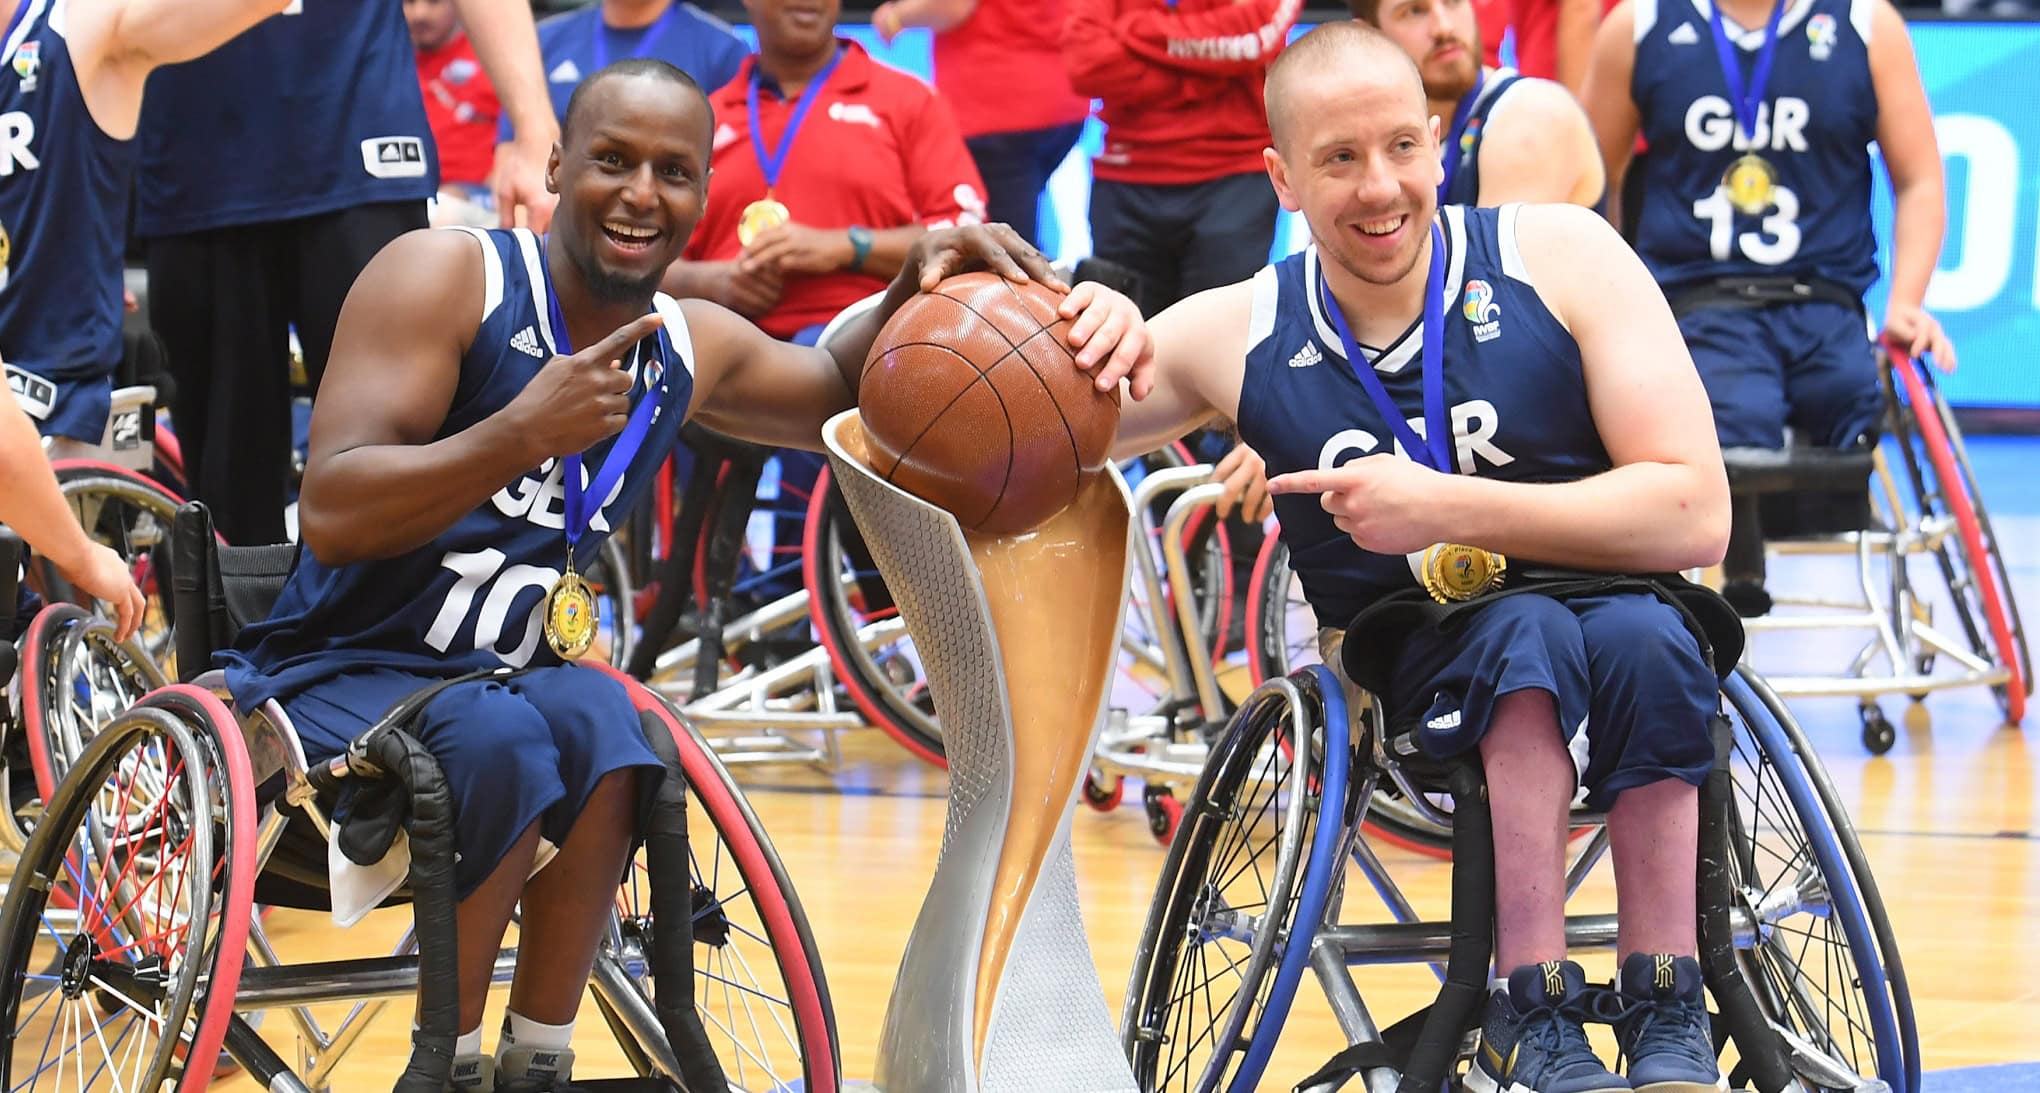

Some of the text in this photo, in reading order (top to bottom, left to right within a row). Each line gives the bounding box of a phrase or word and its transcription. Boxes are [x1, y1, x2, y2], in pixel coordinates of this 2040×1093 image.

[1693, 184, 1801, 265] 13
[510, 337, 544, 358] adidas
[1288, 352, 1323, 368] adidas
[1318, 400, 1515, 475] GR
[424, 547, 561, 669] 10
